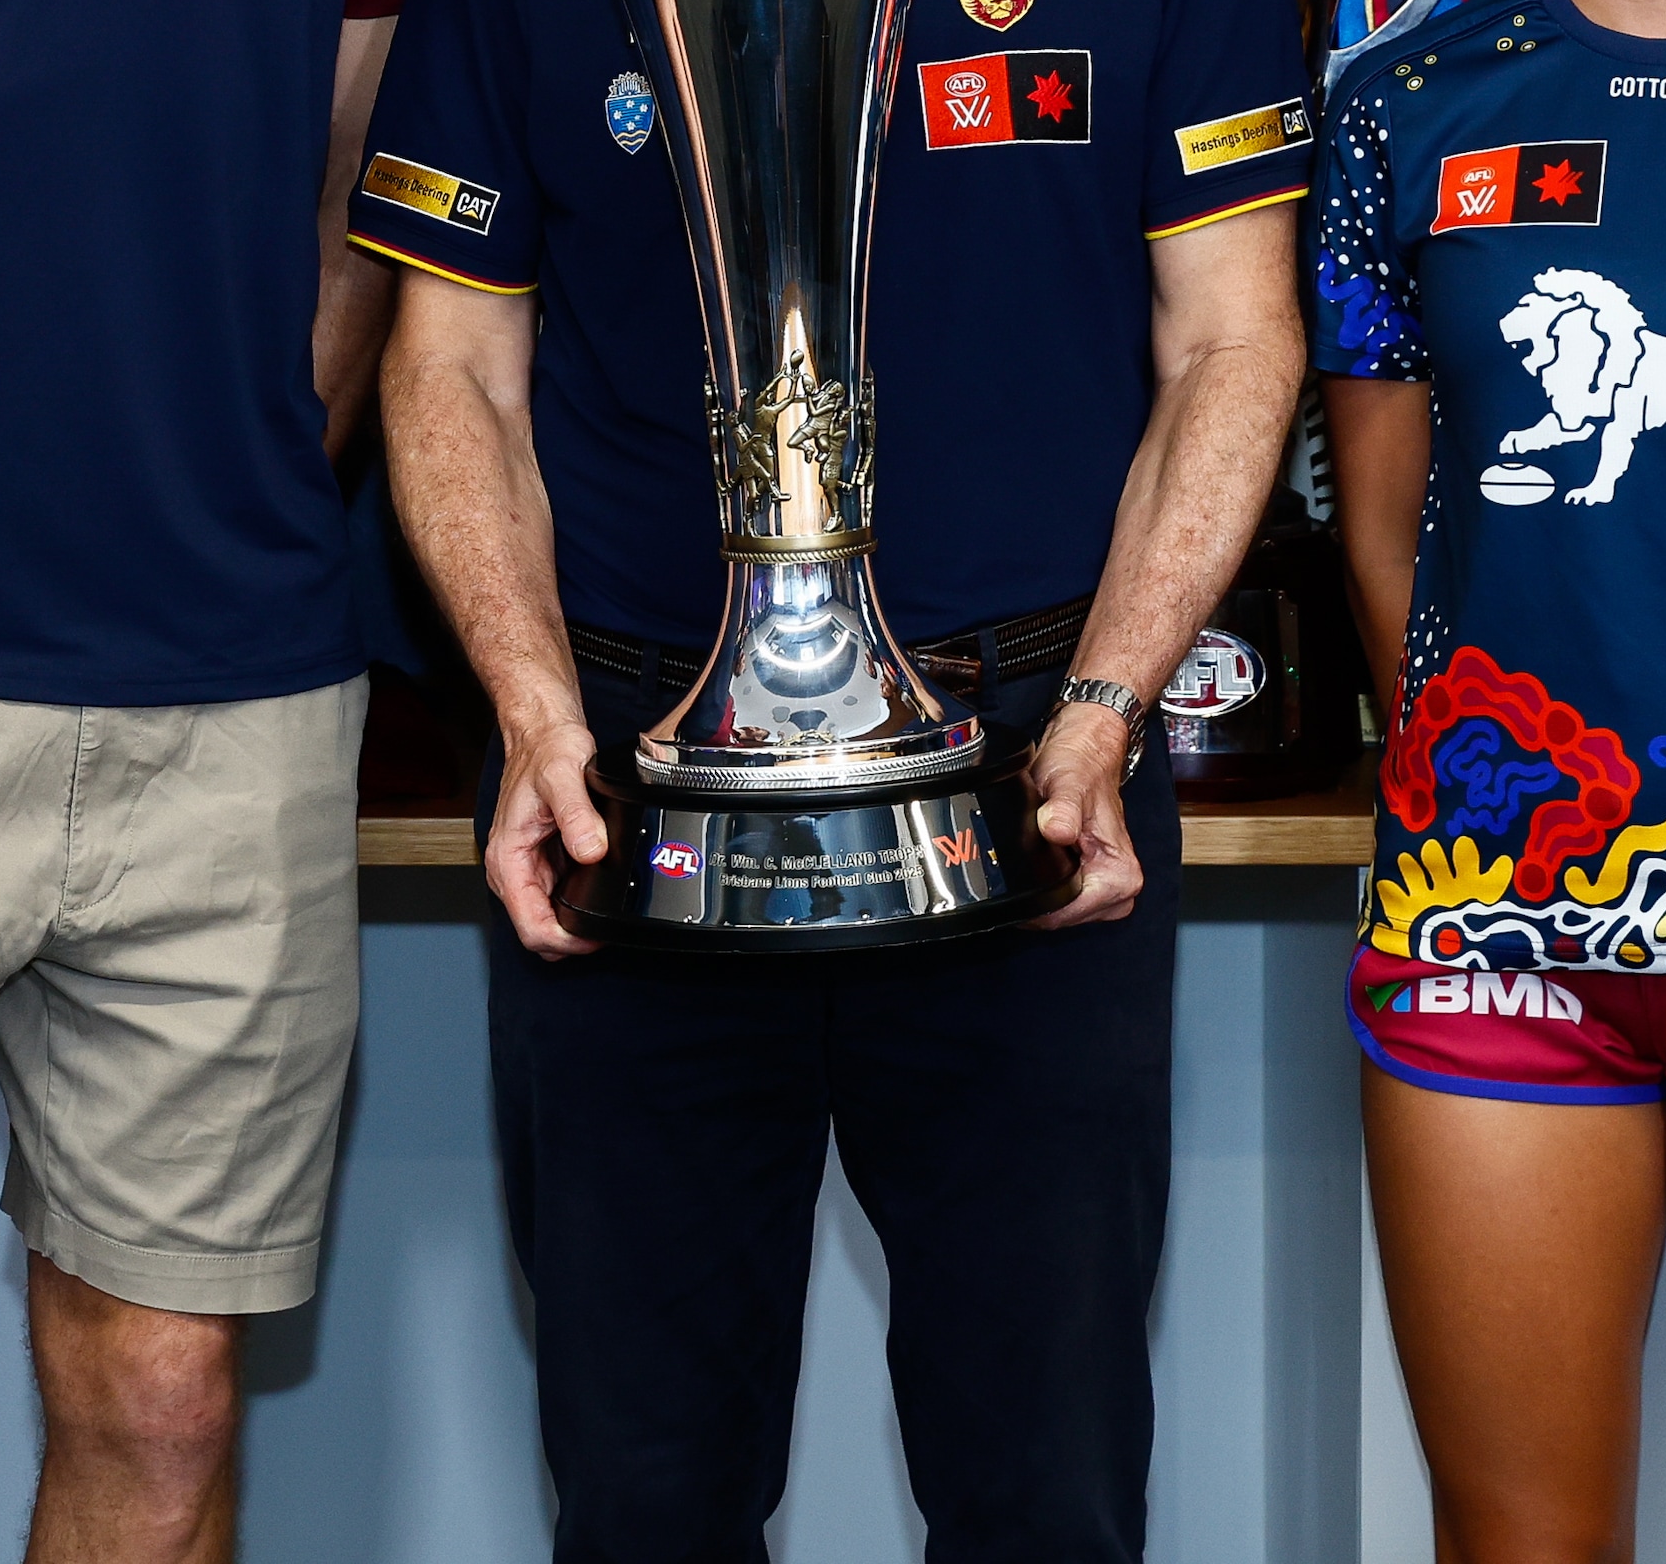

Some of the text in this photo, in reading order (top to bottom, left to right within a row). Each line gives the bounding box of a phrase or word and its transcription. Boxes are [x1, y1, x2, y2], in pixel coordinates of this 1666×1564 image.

[949, 77, 981, 92] AFL
[1283, 109, 1305, 134] CAT
[1191, 122, 1279, 154] Hastings Deering
[1462, 169, 1493, 184] AFL
[410, 179, 450, 206] Deering
[456, 192, 492, 221] CAT
[1165, 646, 1256, 699] FL
[651, 847, 698, 874] AFL
[764, 856, 778, 871] C.
[781, 851, 876, 871] McCLELLAND
[719, 865, 925, 890] Brisbane Lions Football Club 2025
